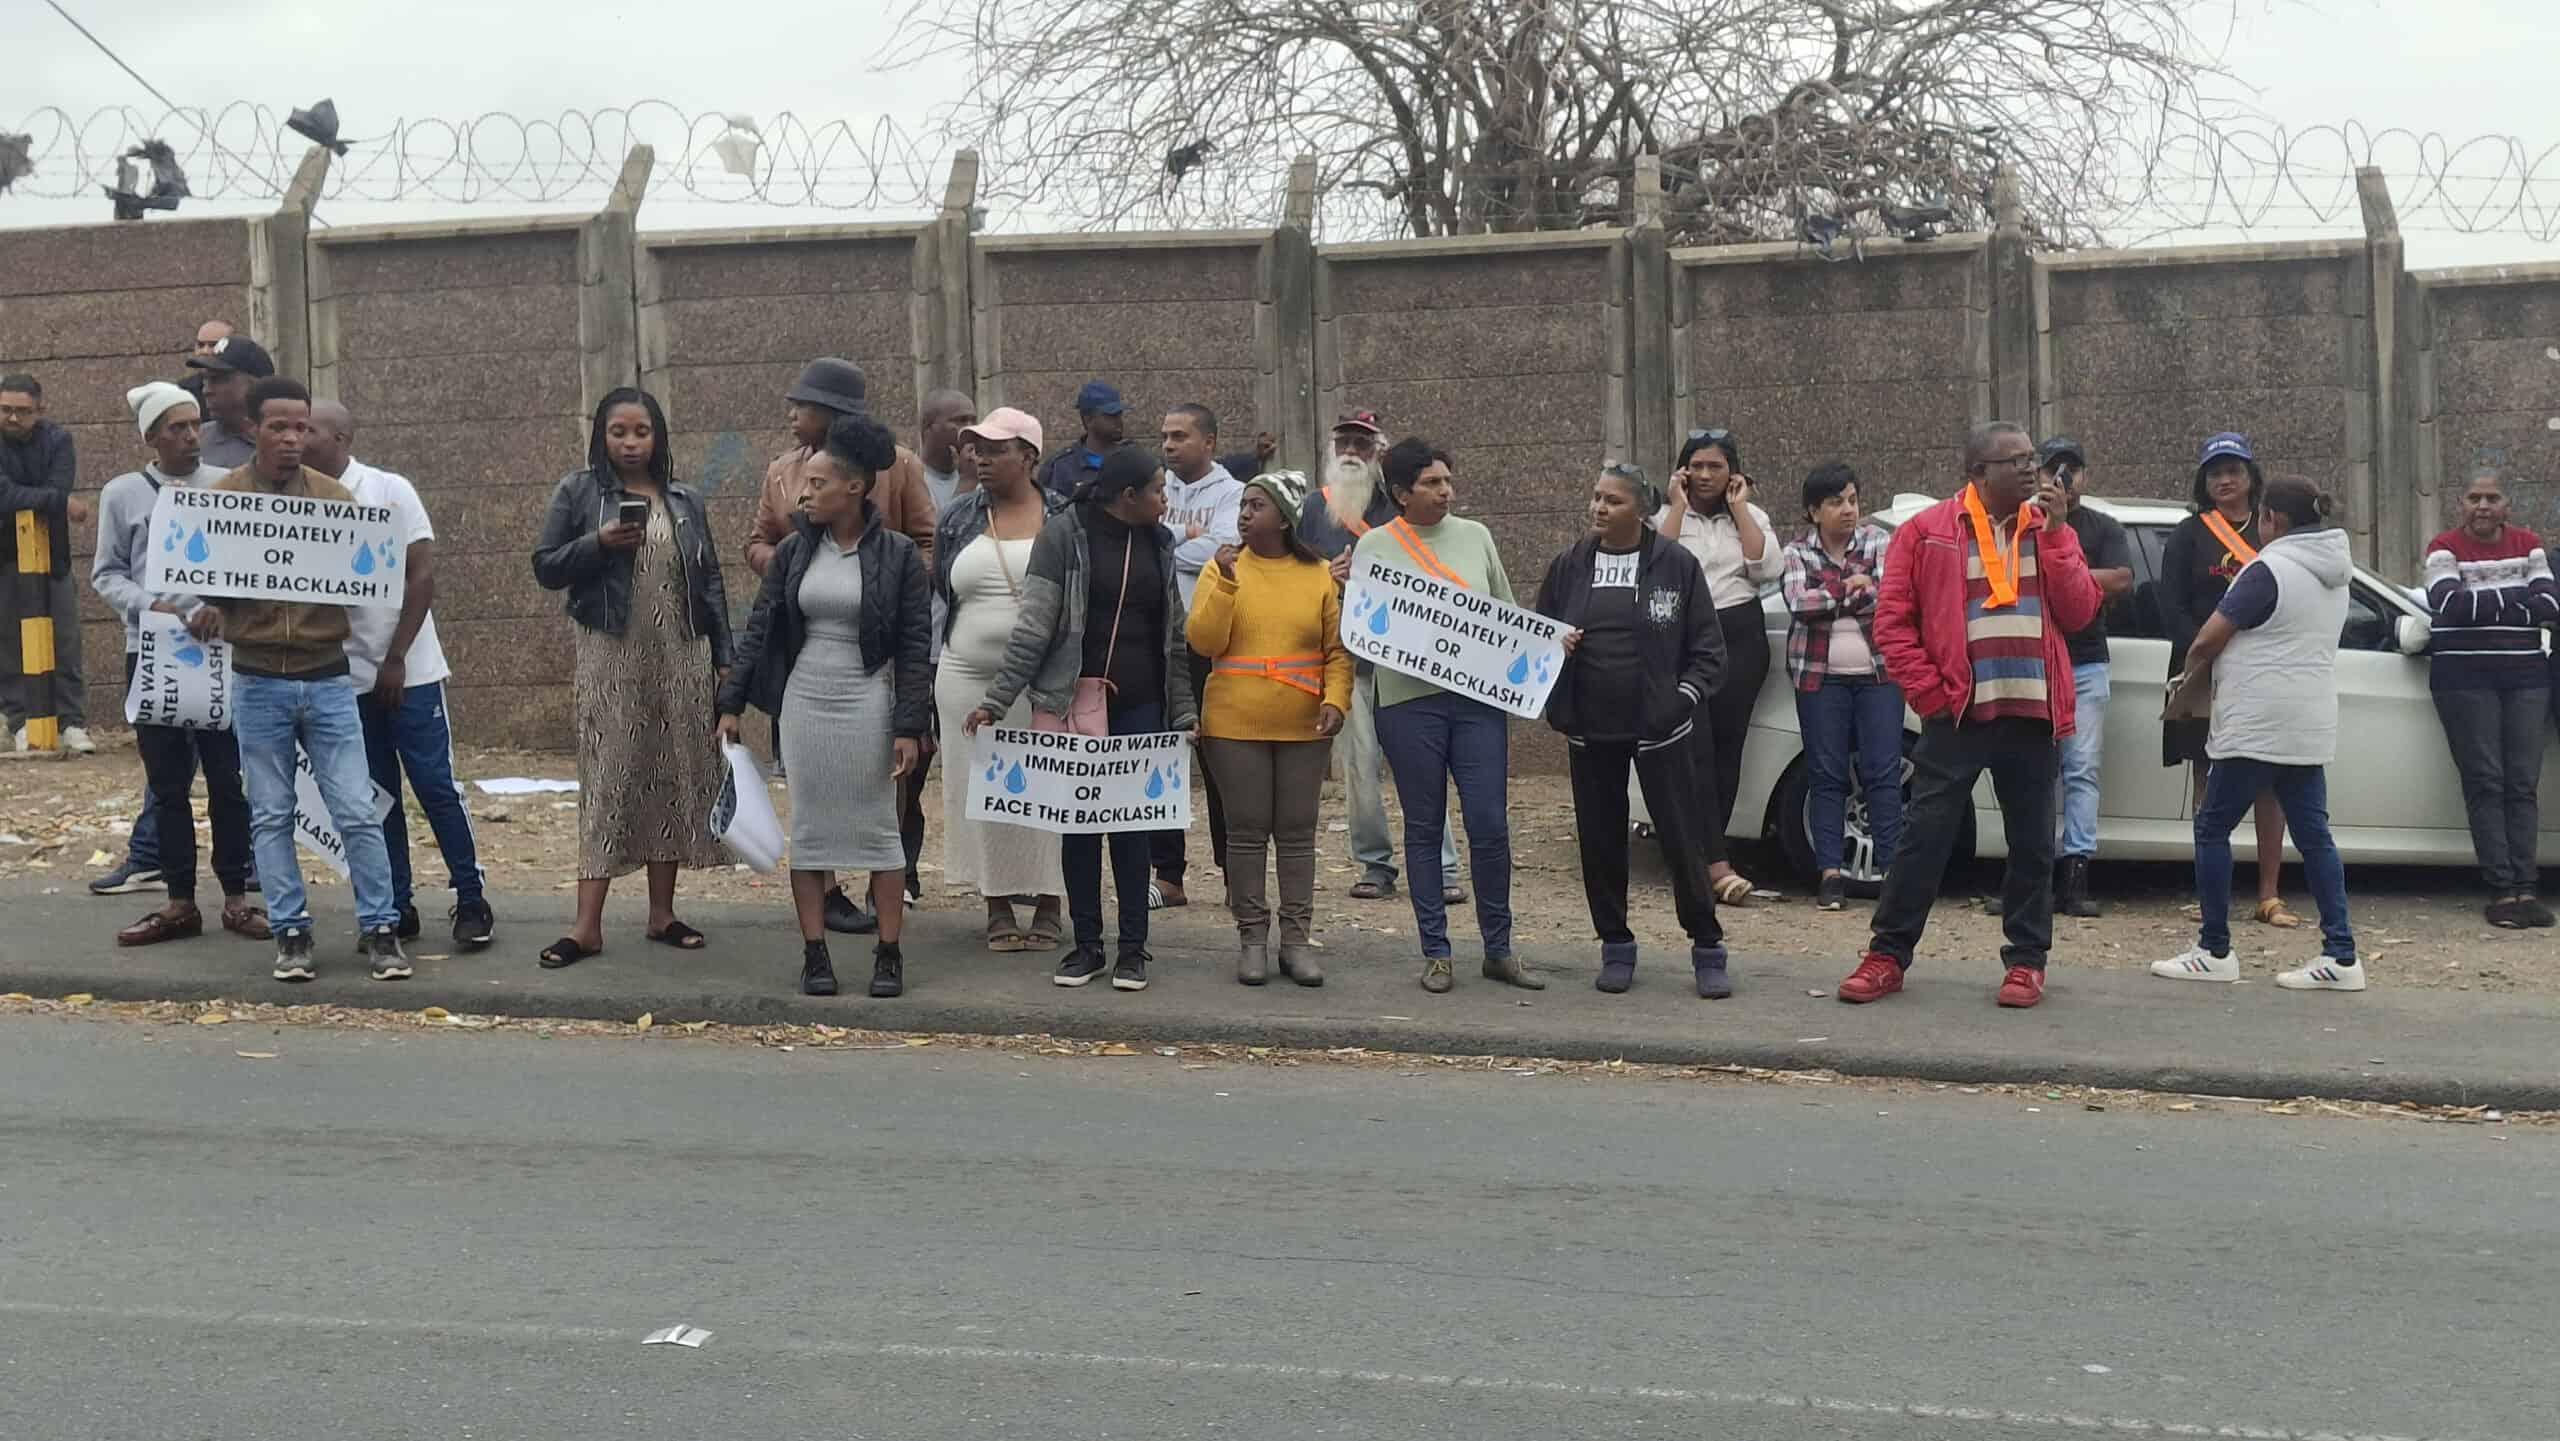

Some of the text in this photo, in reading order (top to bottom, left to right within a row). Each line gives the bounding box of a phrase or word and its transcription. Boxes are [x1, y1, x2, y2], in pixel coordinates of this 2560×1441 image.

[174, 491, 392, 524] RESTORE OUR WATER
[206, 519, 355, 545] IMMEDIATELY !
[264, 549, 295, 565] OR
[164, 568, 389, 599] FACE THE BACKLASH !
[1369, 563, 1556, 641] RESTORE OUR WATER
[1391, 597, 1519, 653] IMMEDIATELY !
[141, 631, 156, 692] WATER
[1435, 638, 1461, 659] OR
[1350, 631, 1535, 711] FACE THE BACKLASH !
[995, 729, 1180, 754] RESTORE OUR WATER
[1025, 754, 1149, 777] IMMEDIATELY !
[1074, 786, 1101, 801] OR
[984, 796, 1177, 824] FACE THE BACKLASH !
